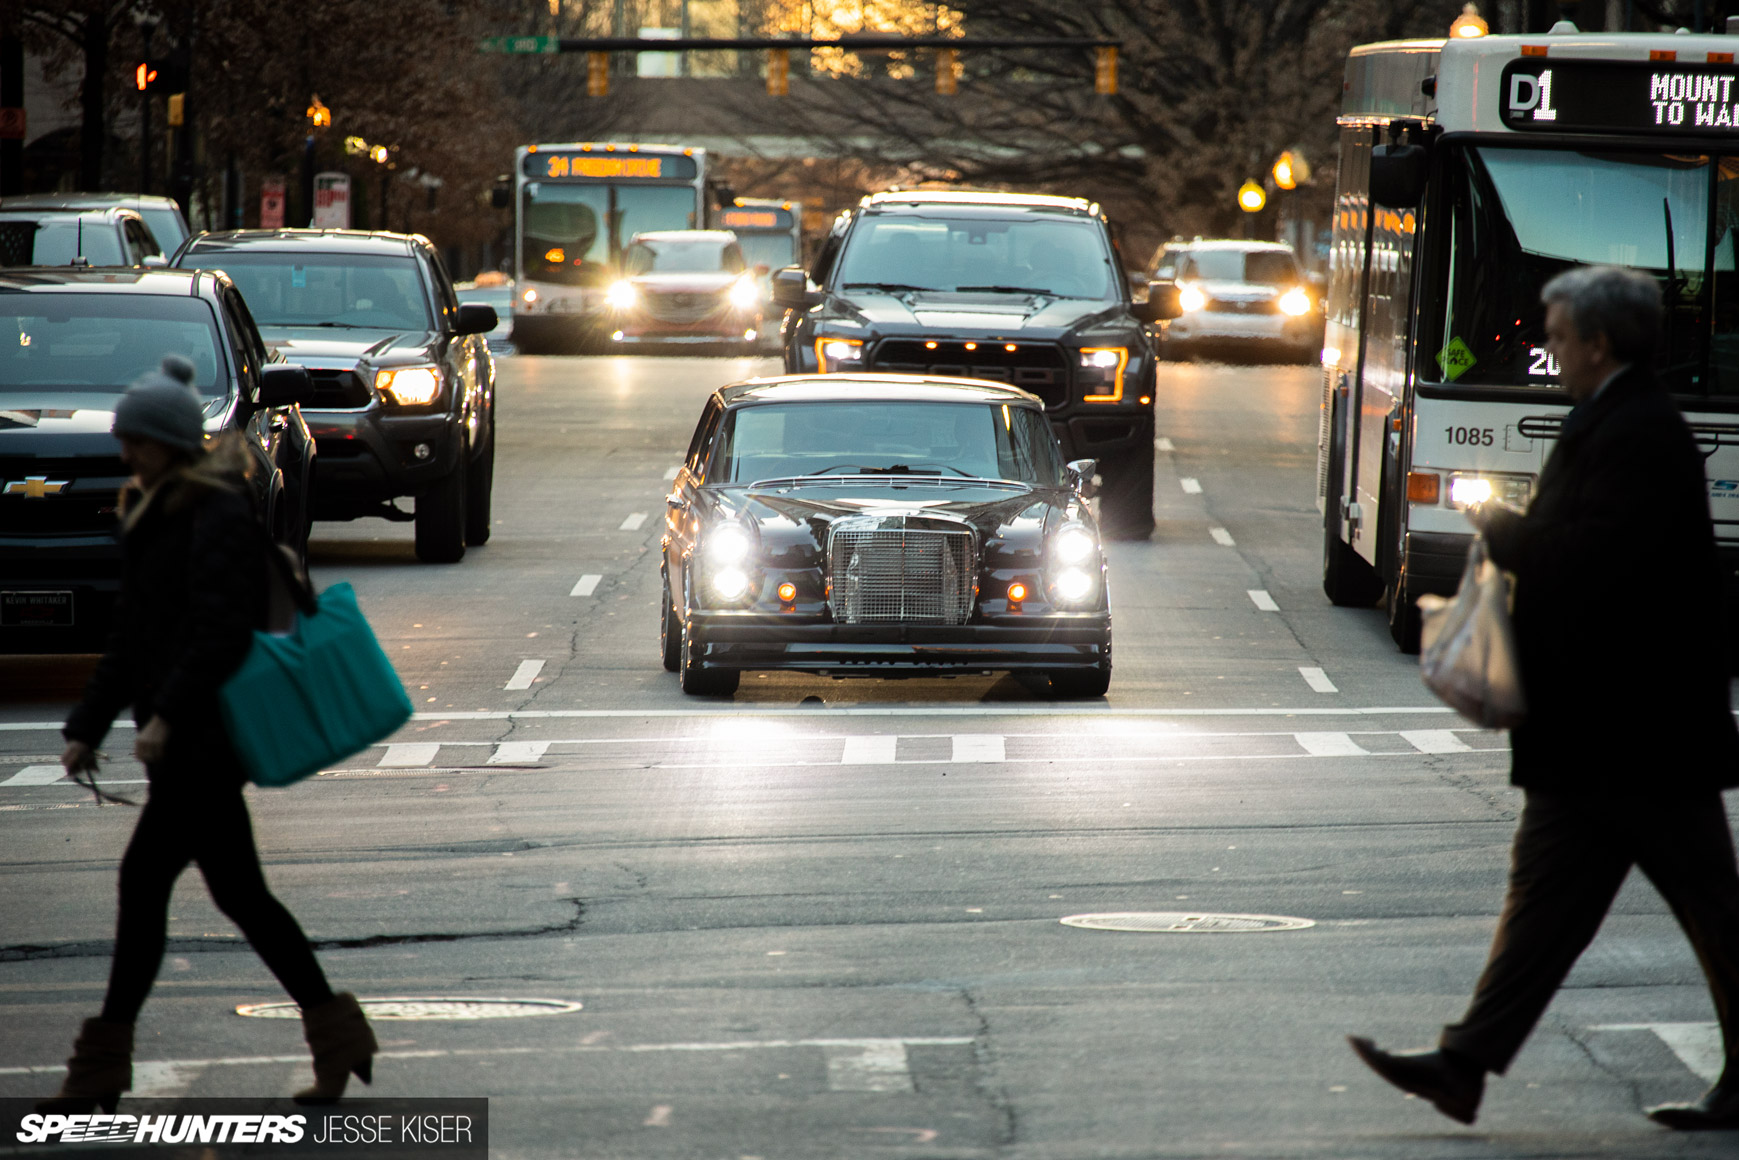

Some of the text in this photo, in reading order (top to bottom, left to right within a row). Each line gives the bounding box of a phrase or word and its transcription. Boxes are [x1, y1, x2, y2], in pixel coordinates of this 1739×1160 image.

[1650, 73, 1735, 102] MOUNT
[1653, 101, 1685, 125] TO
[1445, 426, 1494, 446] 1085
[5, 596, 67, 605] KEVIN WHITAKER
